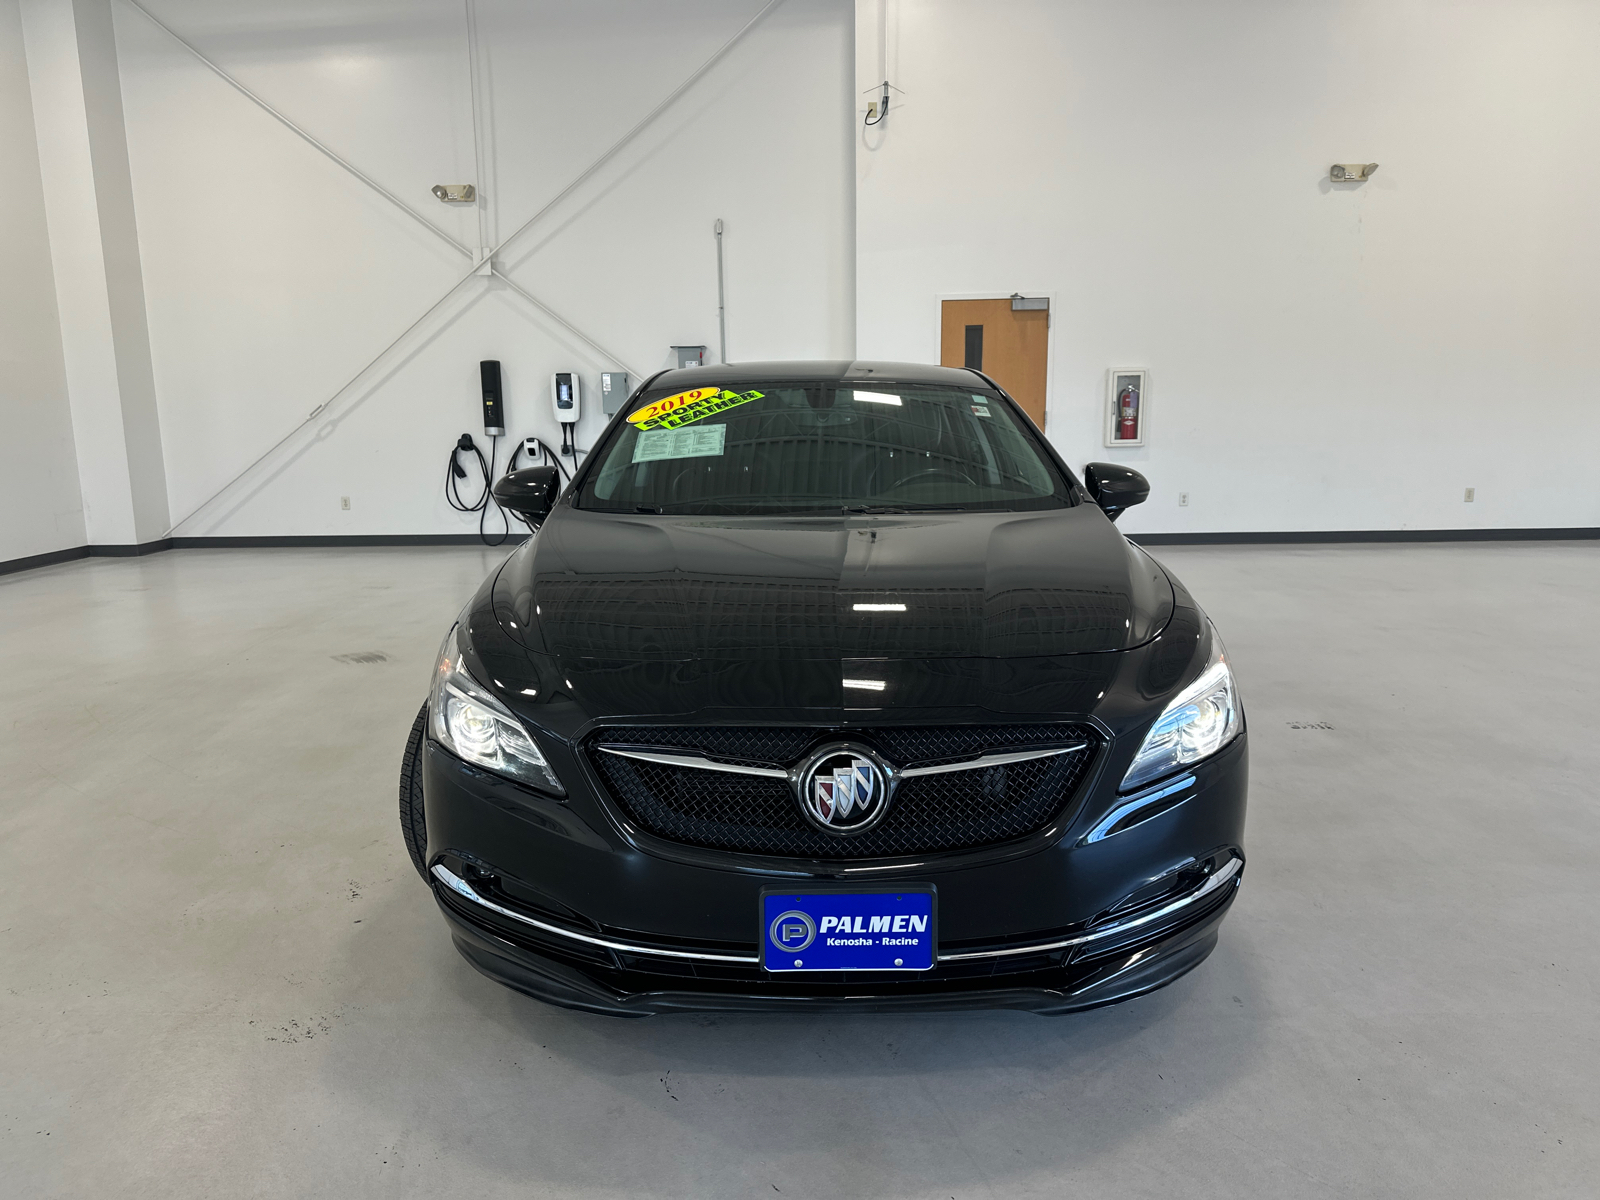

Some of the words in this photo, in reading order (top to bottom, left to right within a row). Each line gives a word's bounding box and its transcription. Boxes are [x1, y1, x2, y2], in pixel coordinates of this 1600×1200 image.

[643, 393, 725, 427] SPORTY
[646, 390, 702, 418] 2019
[667, 391, 755, 427] LEATHER
[819, 915, 928, 934] PALMEN
[826, 937, 873, 946] Kenosha
[882, 937, 919, 946] Racine
